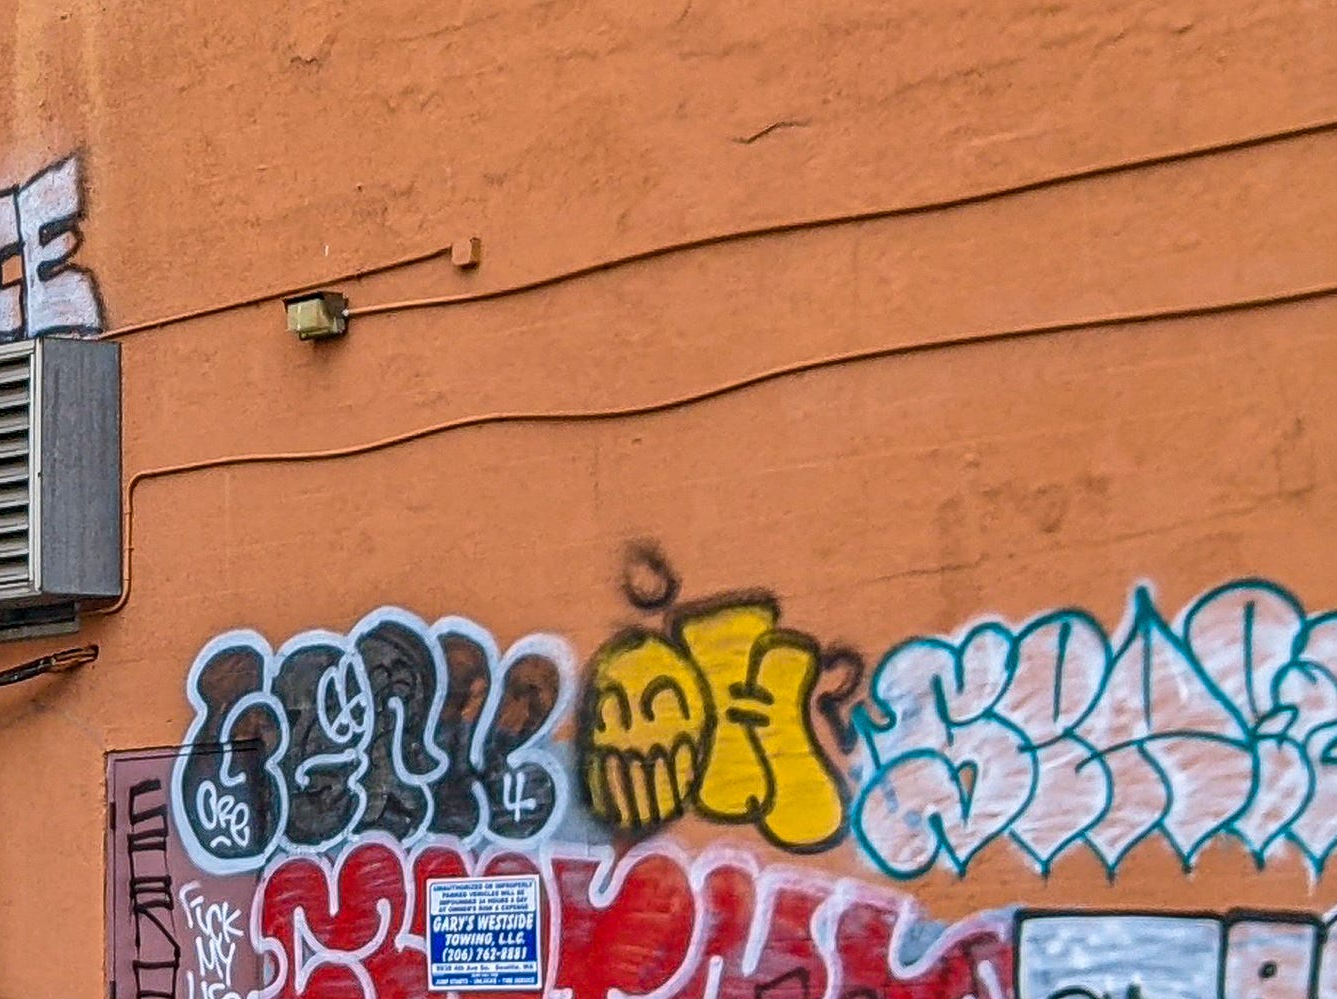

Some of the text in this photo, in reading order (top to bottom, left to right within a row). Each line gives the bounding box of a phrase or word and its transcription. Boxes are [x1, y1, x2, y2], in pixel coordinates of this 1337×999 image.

[433, 914, 533, 932] GARY'S WESTSIDE
[442, 947, 473, 962] (206)
